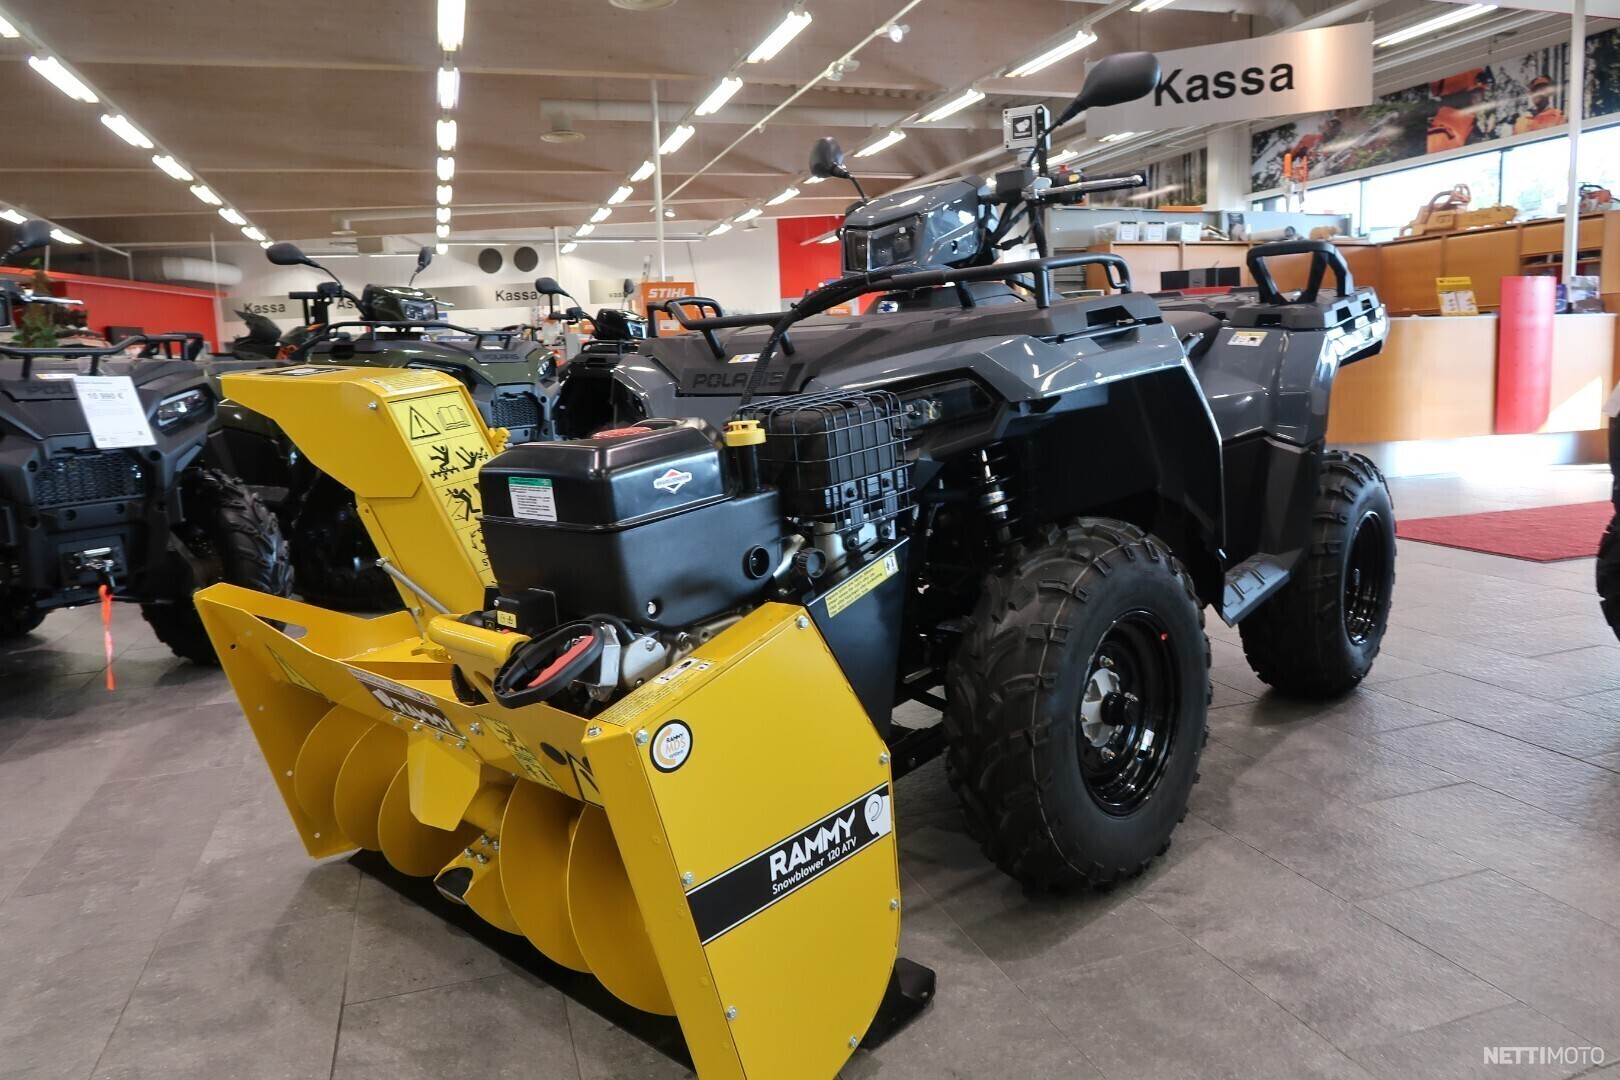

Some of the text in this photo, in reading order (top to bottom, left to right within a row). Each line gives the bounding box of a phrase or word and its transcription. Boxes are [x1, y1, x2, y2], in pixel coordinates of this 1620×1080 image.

[1154, 62, 1295, 107] Kassa
[495, 289, 538, 302] Kassa
[647, 287, 690, 299] STIHL
[243, 302, 286, 314] Kassa
[692, 371, 785, 389] POLAIS
[665, 737, 687, 755] MDS
[769, 808, 856, 882] RAMMY
[772, 836, 857, 895] Snowblower 120 ATV
